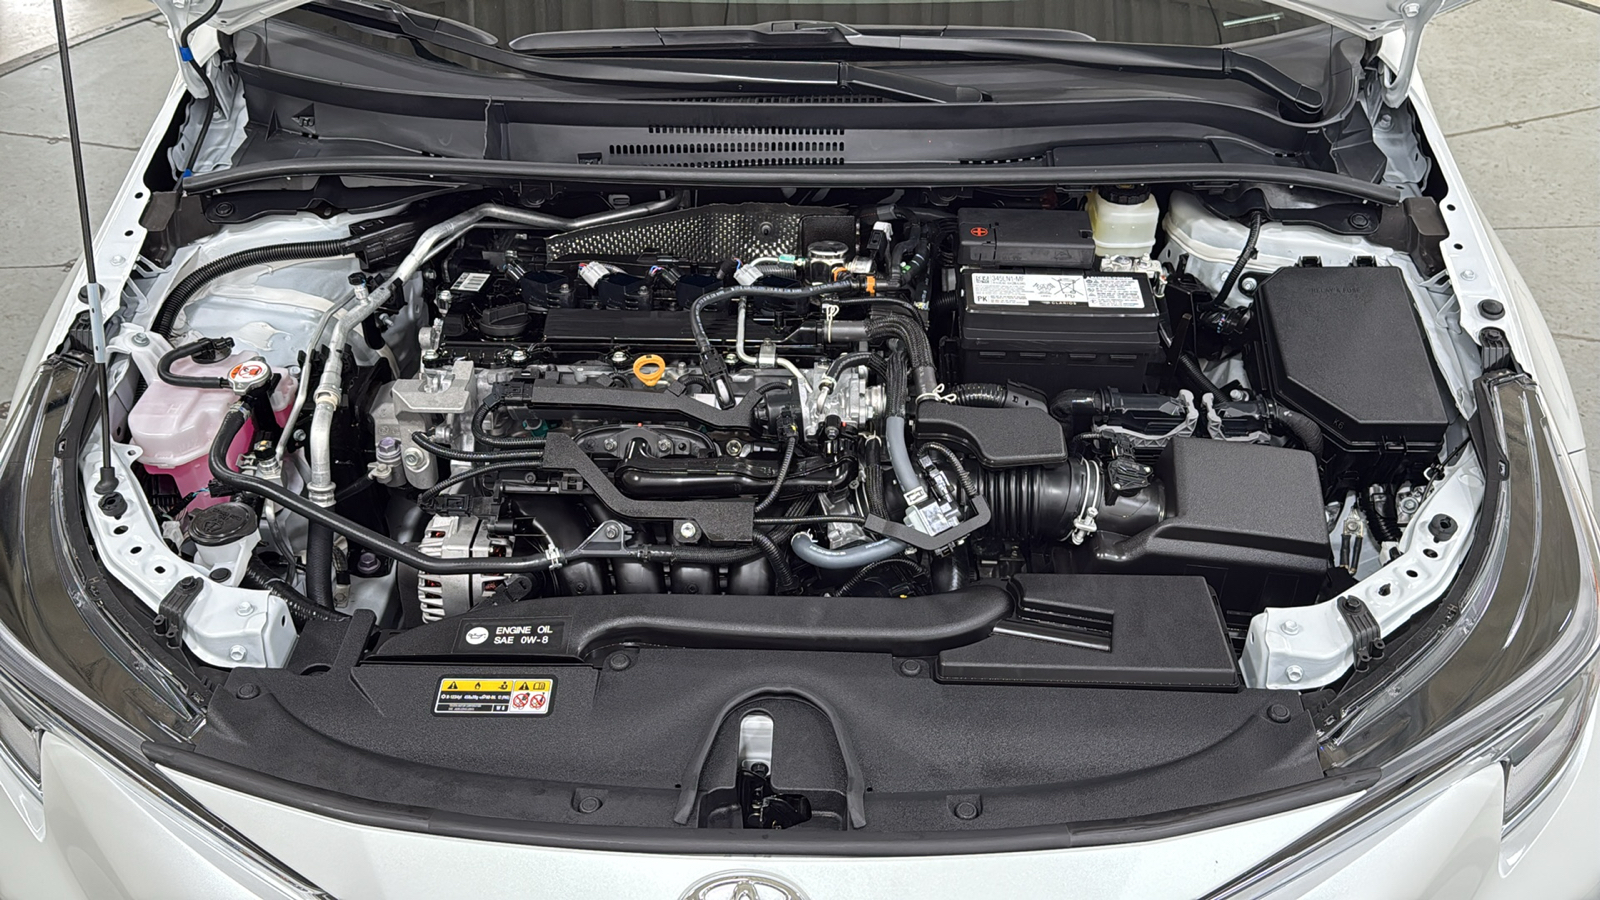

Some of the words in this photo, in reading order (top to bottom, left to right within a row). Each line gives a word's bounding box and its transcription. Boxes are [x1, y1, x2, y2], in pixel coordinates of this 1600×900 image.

[495, 625, 532, 635] ENGINE
[537, 625, 553, 634] OIL
[493, 636, 514, 645] SAE
[520, 635, 549, 644] 0W-8
